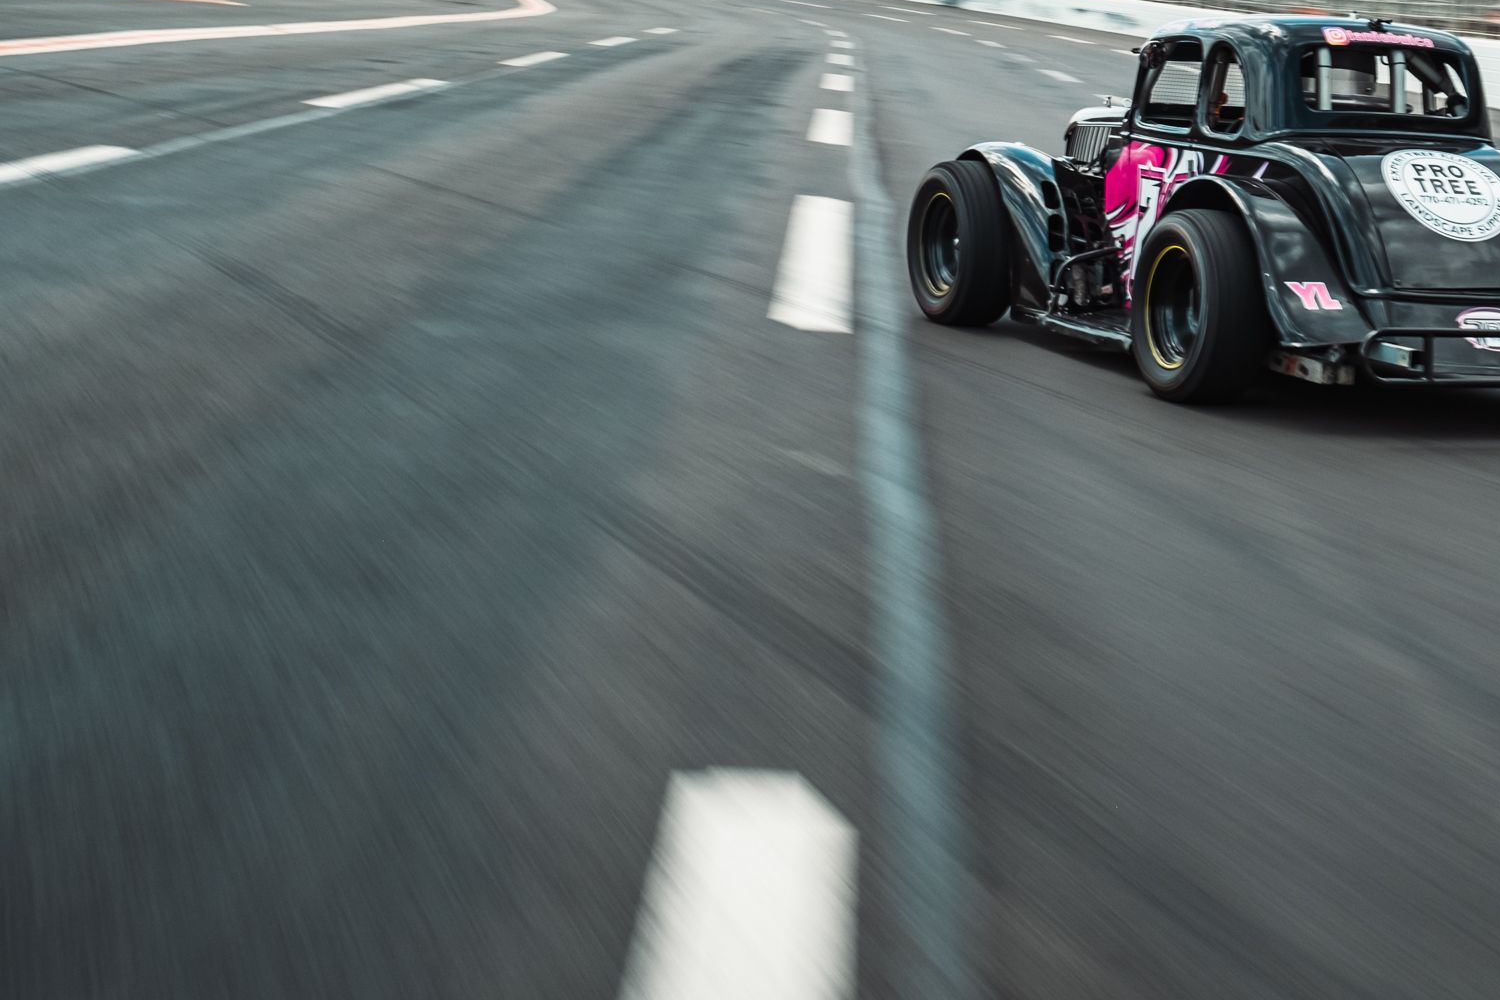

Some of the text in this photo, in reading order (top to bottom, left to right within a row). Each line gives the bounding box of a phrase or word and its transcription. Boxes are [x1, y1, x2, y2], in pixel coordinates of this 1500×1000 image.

[1411, 163, 1464, 179] PRO
[1413, 178, 1483, 196] TREE
[1401, 192, 1475, 236] LANDSCAPE
[1283, 281, 1344, 311] YL
